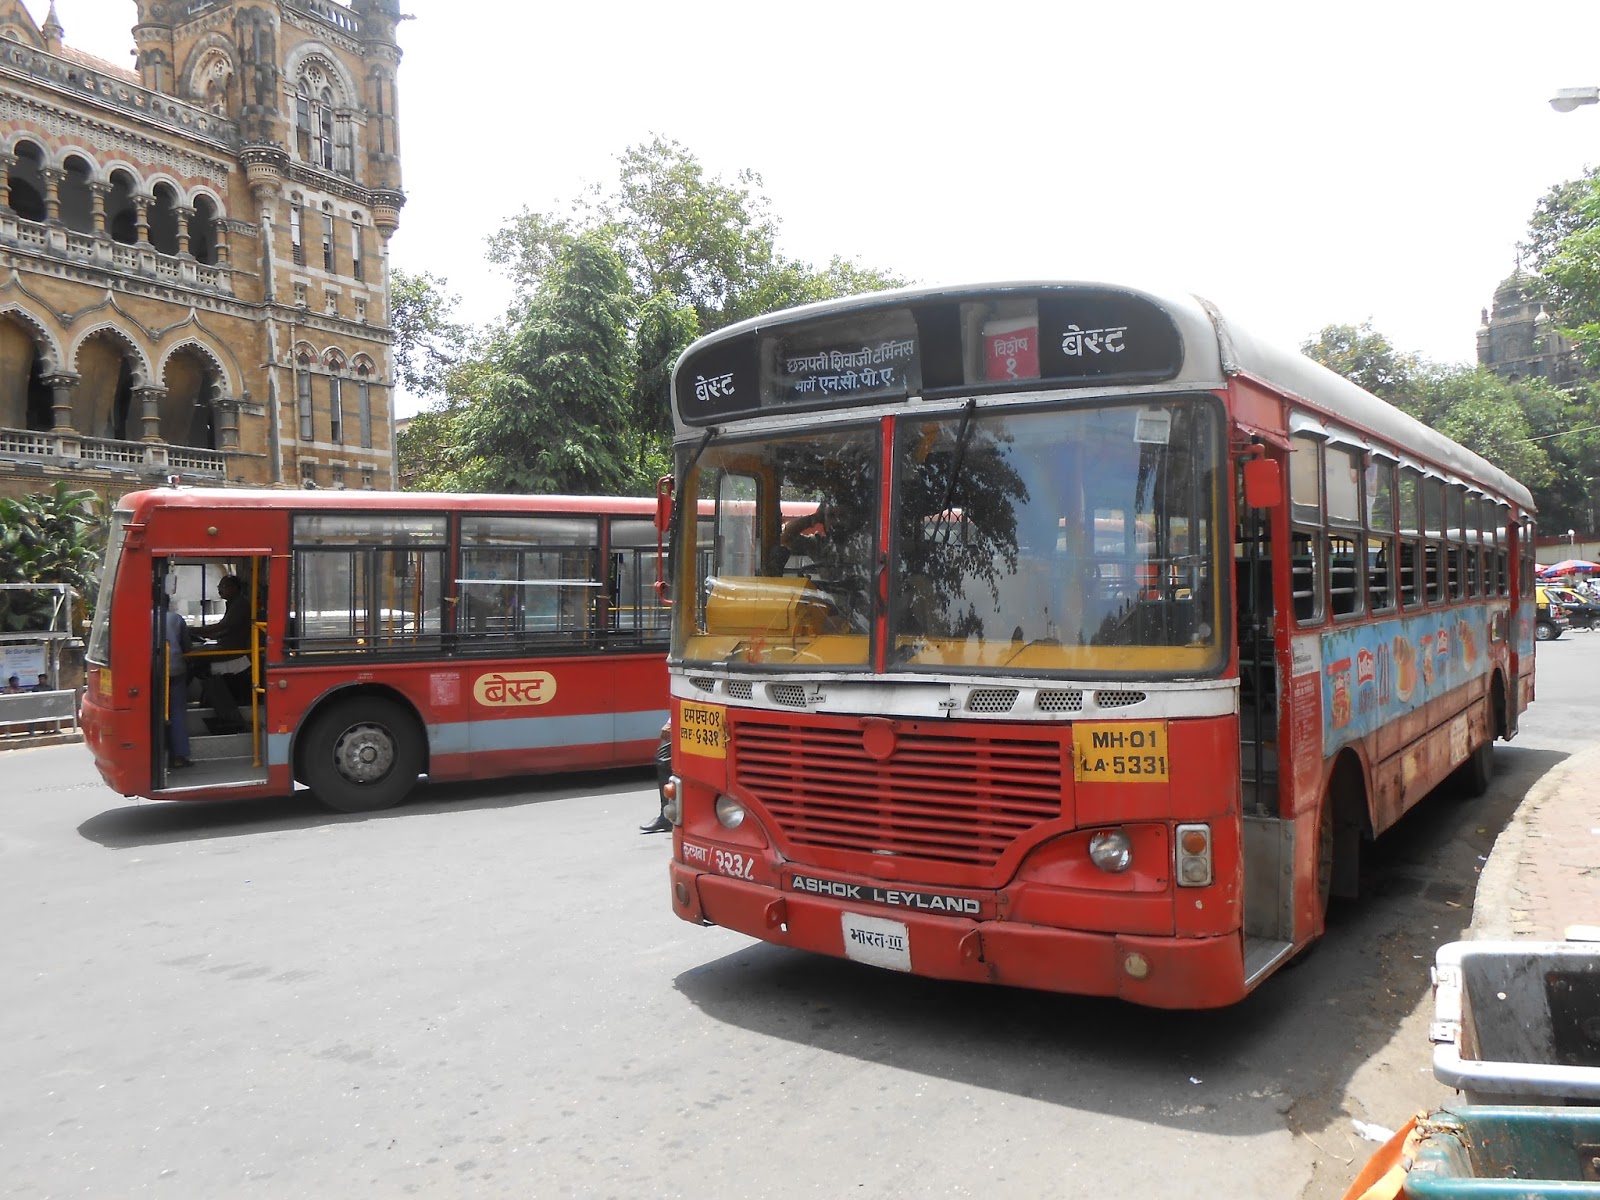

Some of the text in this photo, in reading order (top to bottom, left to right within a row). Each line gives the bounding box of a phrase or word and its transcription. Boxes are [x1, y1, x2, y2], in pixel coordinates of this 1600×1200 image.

[993, 336, 1029, 358] विशेष
[1061, 324, 1128, 356] बेस्ट
[786, 339, 915, 373] छत्रपती शिवाजी टर्मिनस
[1006, 357, 1018, 379] १
[695, 373, 735, 401] बेस्ट
[484, 674, 545, 703] बेस्ट
[793, 876, 980, 914] ASHOK LEYLAND
